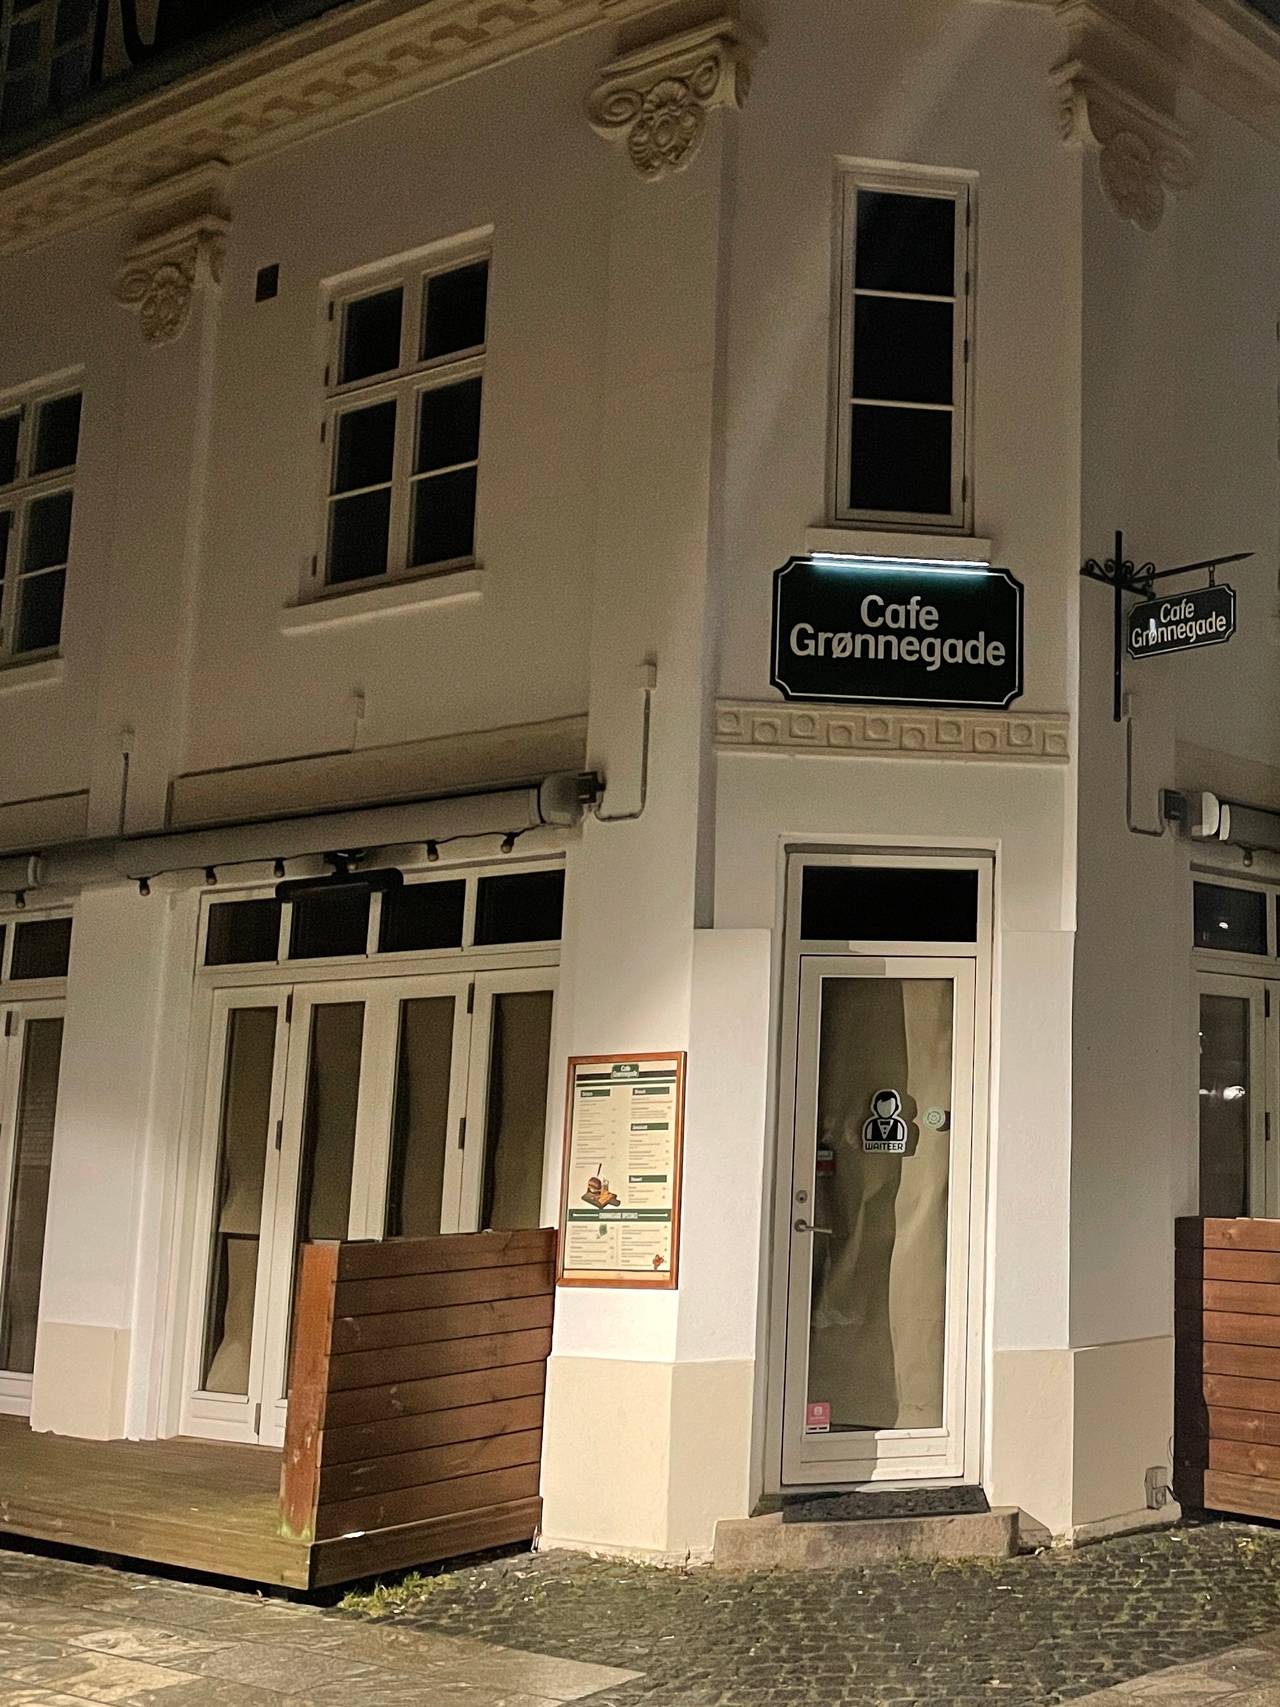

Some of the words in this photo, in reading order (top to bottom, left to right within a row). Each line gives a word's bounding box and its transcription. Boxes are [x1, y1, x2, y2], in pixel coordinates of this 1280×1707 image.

[860, 594, 939, 631] Cafe
[1160, 598, 1195, 623] Cafe
[789, 622, 1006, 672] Grønnegade
[1131, 611, 1227, 648] Grønnegade
[865, 1142, 903, 1150] WAITEER
